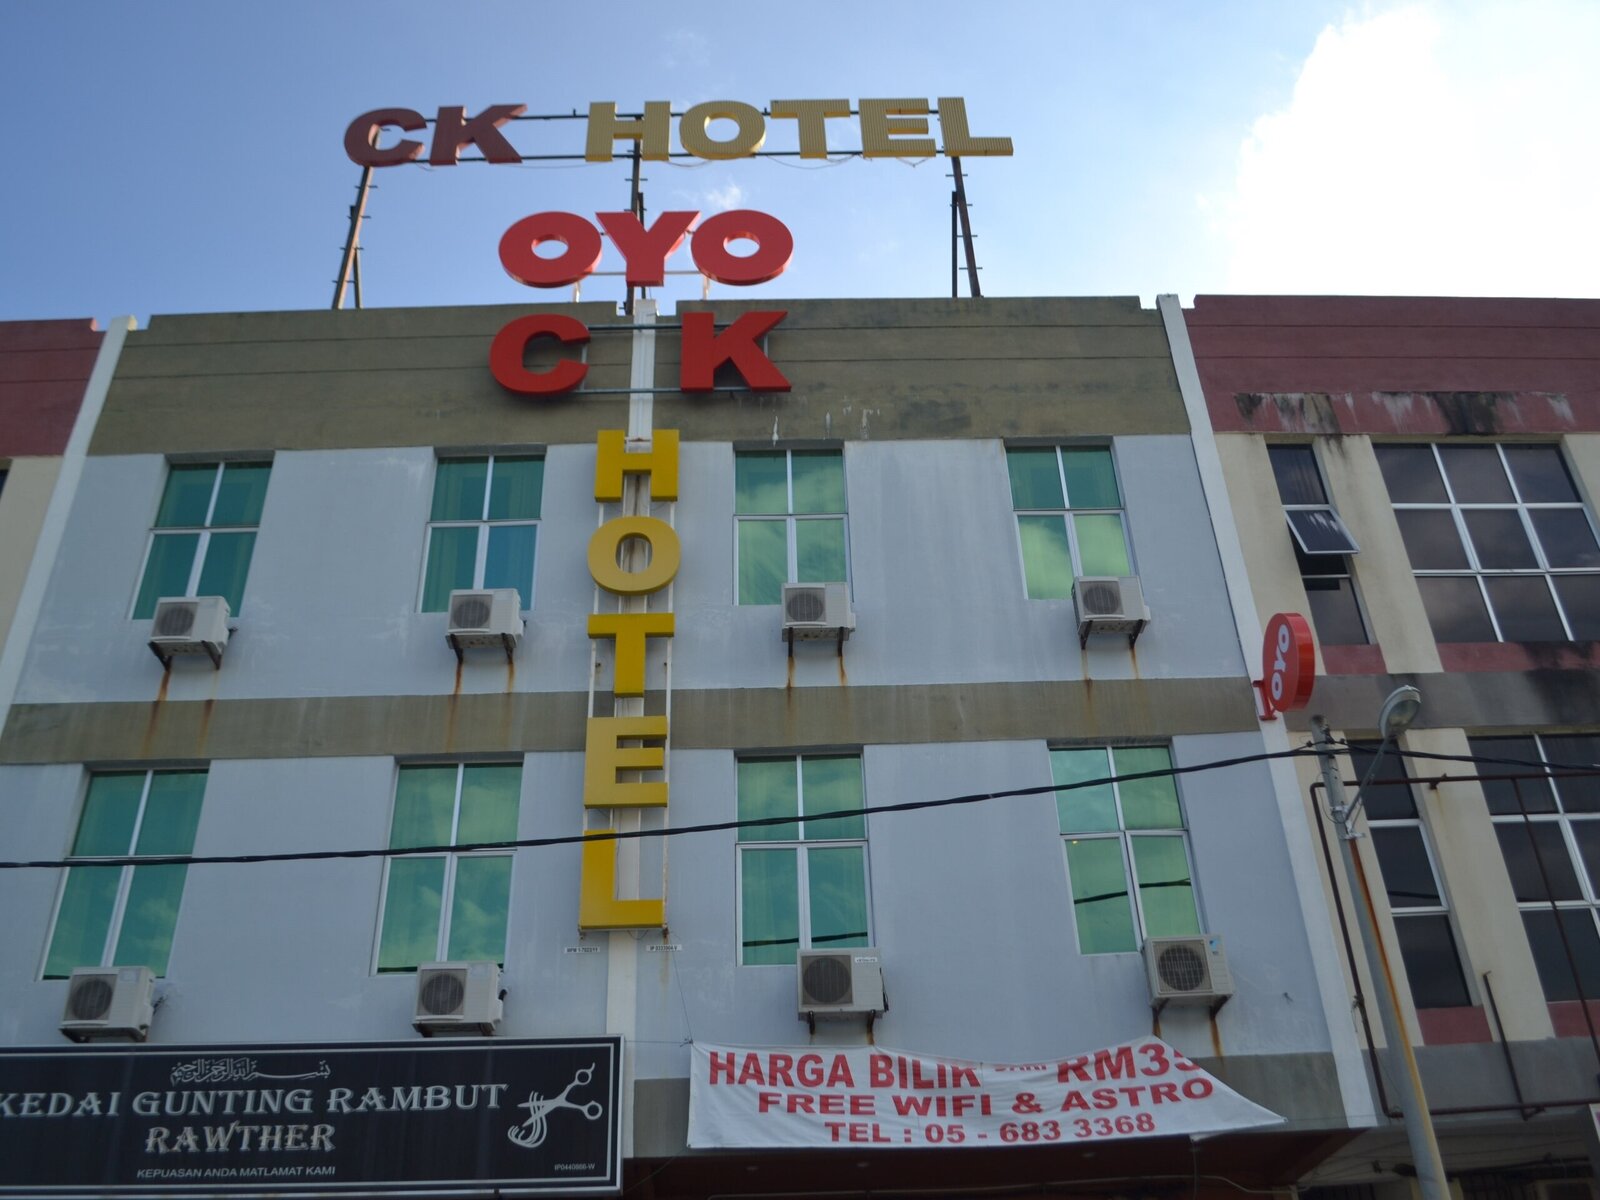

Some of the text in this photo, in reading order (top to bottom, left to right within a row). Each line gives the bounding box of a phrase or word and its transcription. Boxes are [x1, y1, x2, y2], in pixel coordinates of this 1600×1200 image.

[343, 96, 1014, 167] CK HOTEL
[498, 209, 793, 288] OYO
[579, 429, 682, 929] HOTEL
[1271, 624, 1290, 700] OYO
[708, 1051, 855, 1088] HARGA
[869, 1053, 981, 1089] BILIK
[0, 1083, 510, 1118] KEDAI GUNTING RAMBUT
[758, 1077, 1214, 1117] FREE WIFI & ASTRO
[145, 1120, 337, 1154] RAWTHER
[925, 1123, 966, 1144] 05
[999, 1119, 1062, 1143] 683
[1073, 1112, 1156, 1139] 3368
[136, 1166, 336, 1179] KEPUASAN ANDA MATLAMAT KAMI
